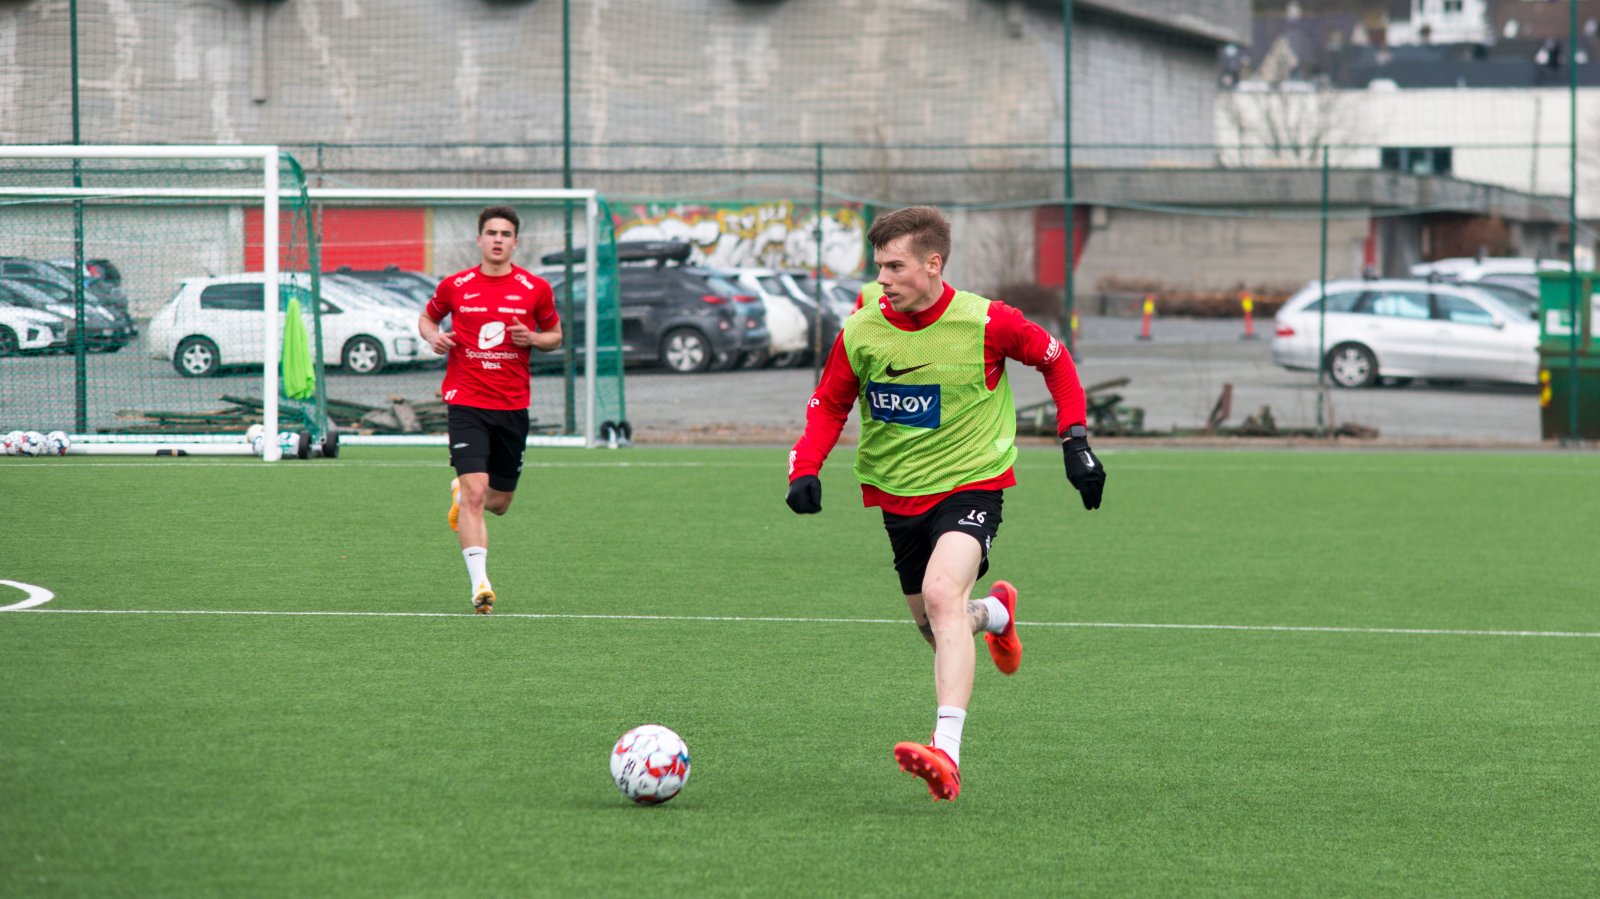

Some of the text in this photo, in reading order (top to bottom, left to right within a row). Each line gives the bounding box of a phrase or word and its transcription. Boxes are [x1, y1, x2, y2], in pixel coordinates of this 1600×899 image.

[465, 348, 519, 359] Sparebanken
[481, 360, 502, 370] Vest
[870, 391, 933, 413] LERØY
[967, 509, 987, 524] 16
